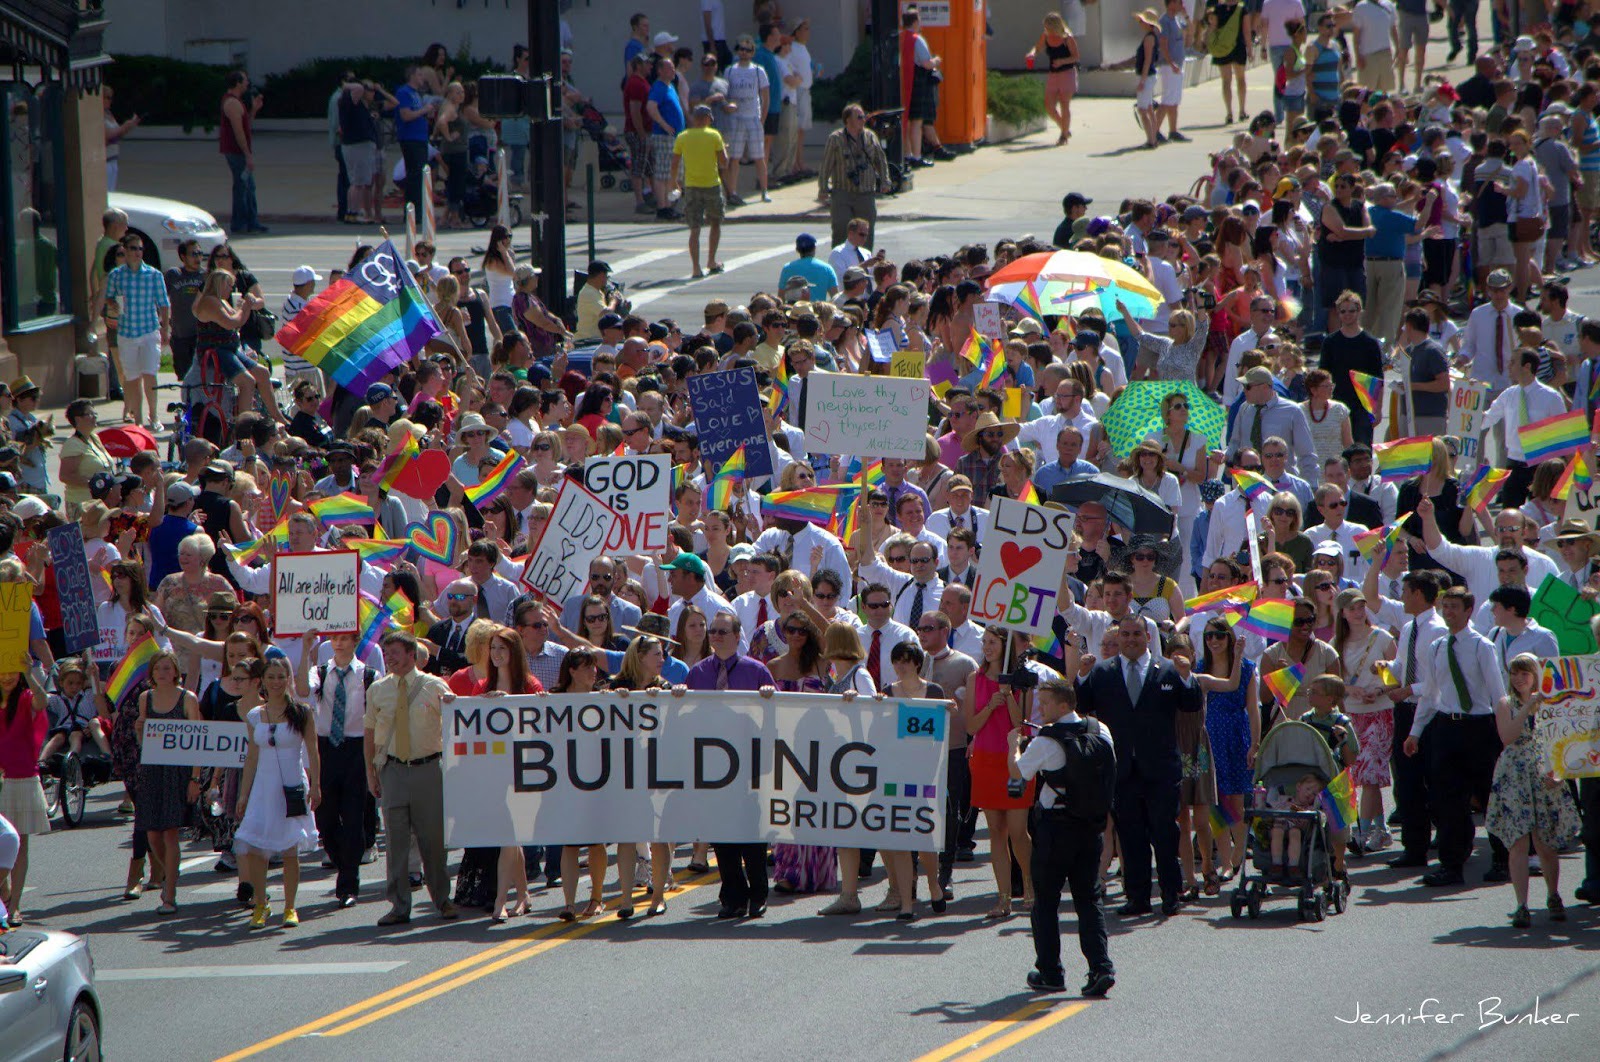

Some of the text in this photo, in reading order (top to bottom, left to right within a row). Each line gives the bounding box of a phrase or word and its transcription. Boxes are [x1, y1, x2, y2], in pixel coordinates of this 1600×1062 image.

[691, 369, 752, 395] JESUS
[832, 380, 896, 405] Love thy
[696, 389, 735, 412] Said
[817, 401, 909, 418] neighbor as
[696, 414, 743, 434] LOVE
[838, 417, 892, 437] thyself
[701, 434, 766, 456] Everyone
[585, 459, 660, 494] GOD
[608, 493, 629, 511] IS
[558, 494, 608, 551] LDS
[605, 511, 666, 551] OVE
[994, 498, 1071, 550] LDS
[295, 580, 312, 594] are
[313, 573, 336, 596] alike
[337, 575, 356, 596] unto
[526, 551, 582, 605] LGBT
[970, 574, 1056, 628] LGBT
[147, 723, 209, 734] MORMONS
[454, 703, 659, 736] MORMONS
[906, 715, 935, 736] 84
[513, 737, 878, 795] BUILDING
[770, 798, 935, 834] BRIDGES
